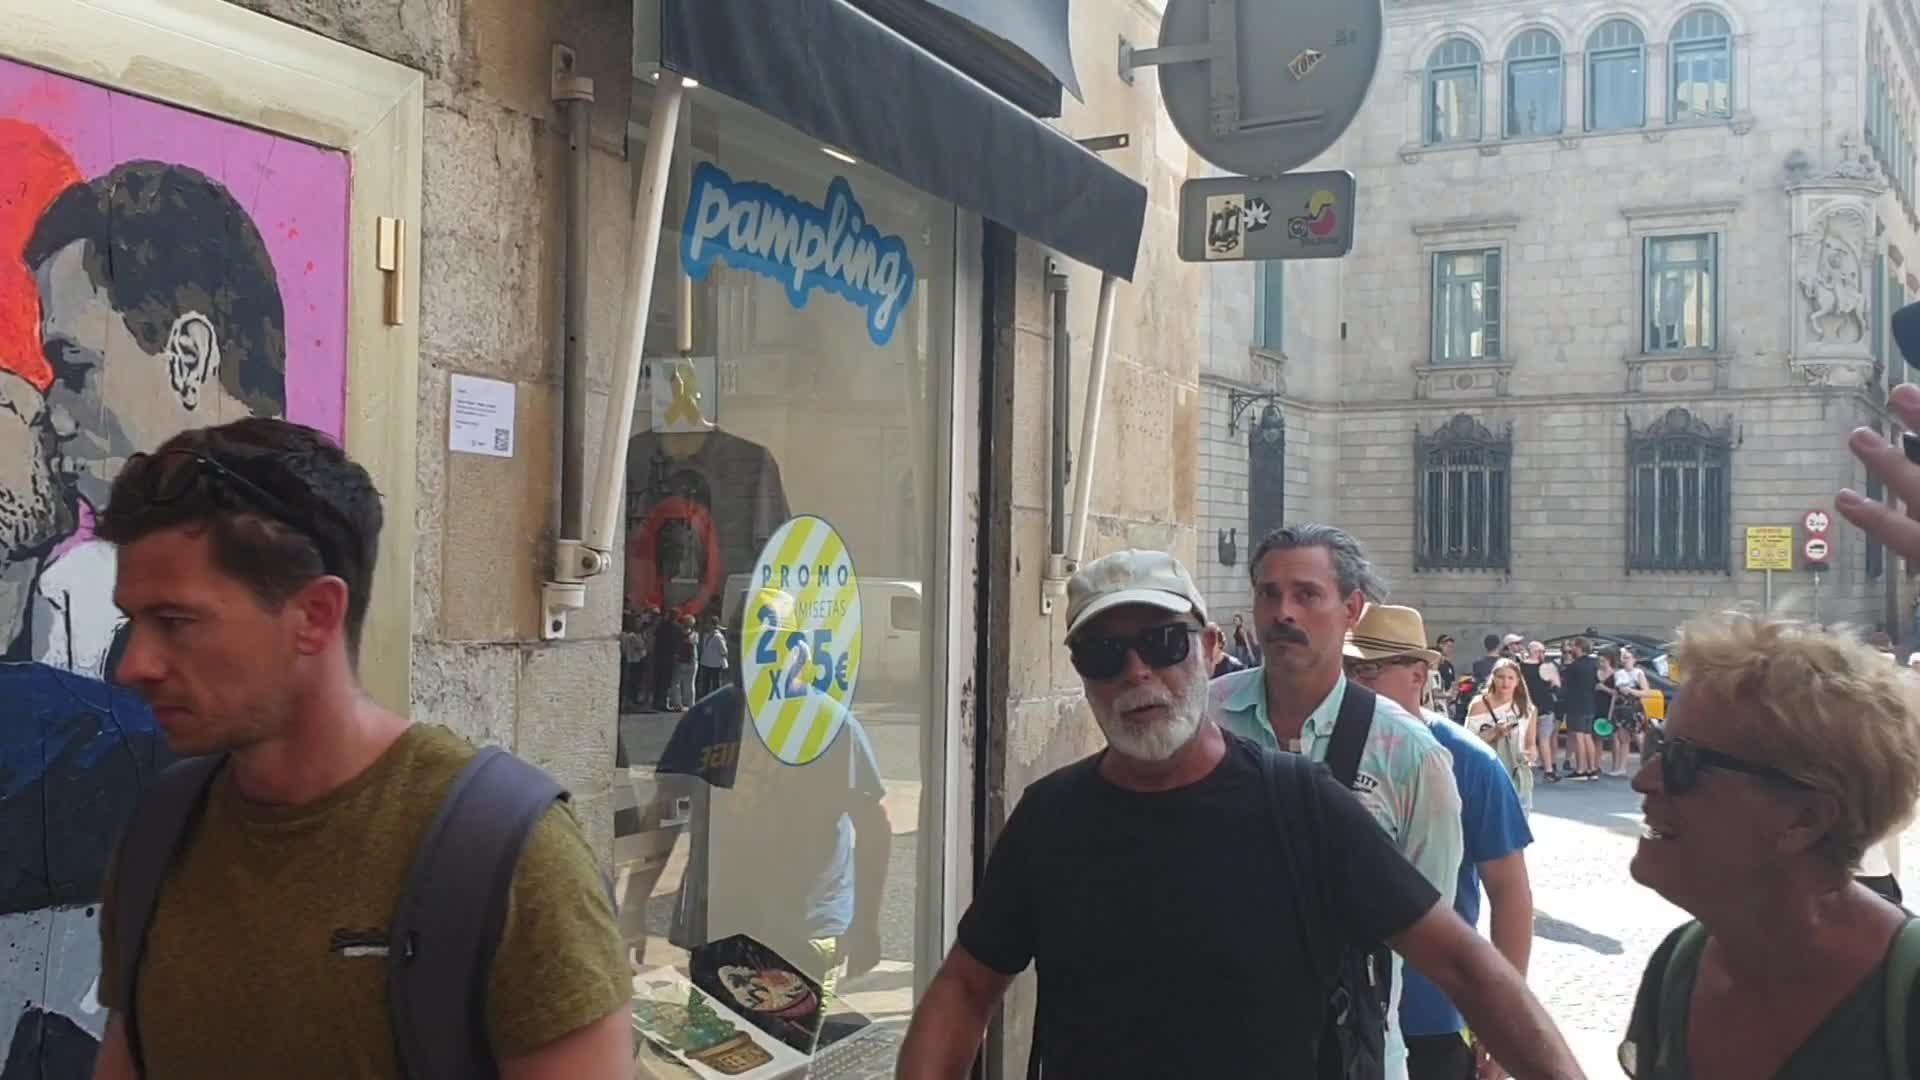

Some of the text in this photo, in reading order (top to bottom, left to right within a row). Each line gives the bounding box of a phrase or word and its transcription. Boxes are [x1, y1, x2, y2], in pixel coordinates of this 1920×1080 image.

[691, 181, 905, 331] pampling
[762, 565, 848, 588] PROMO
[756, 600, 846, 665] 2 AMISETAS
